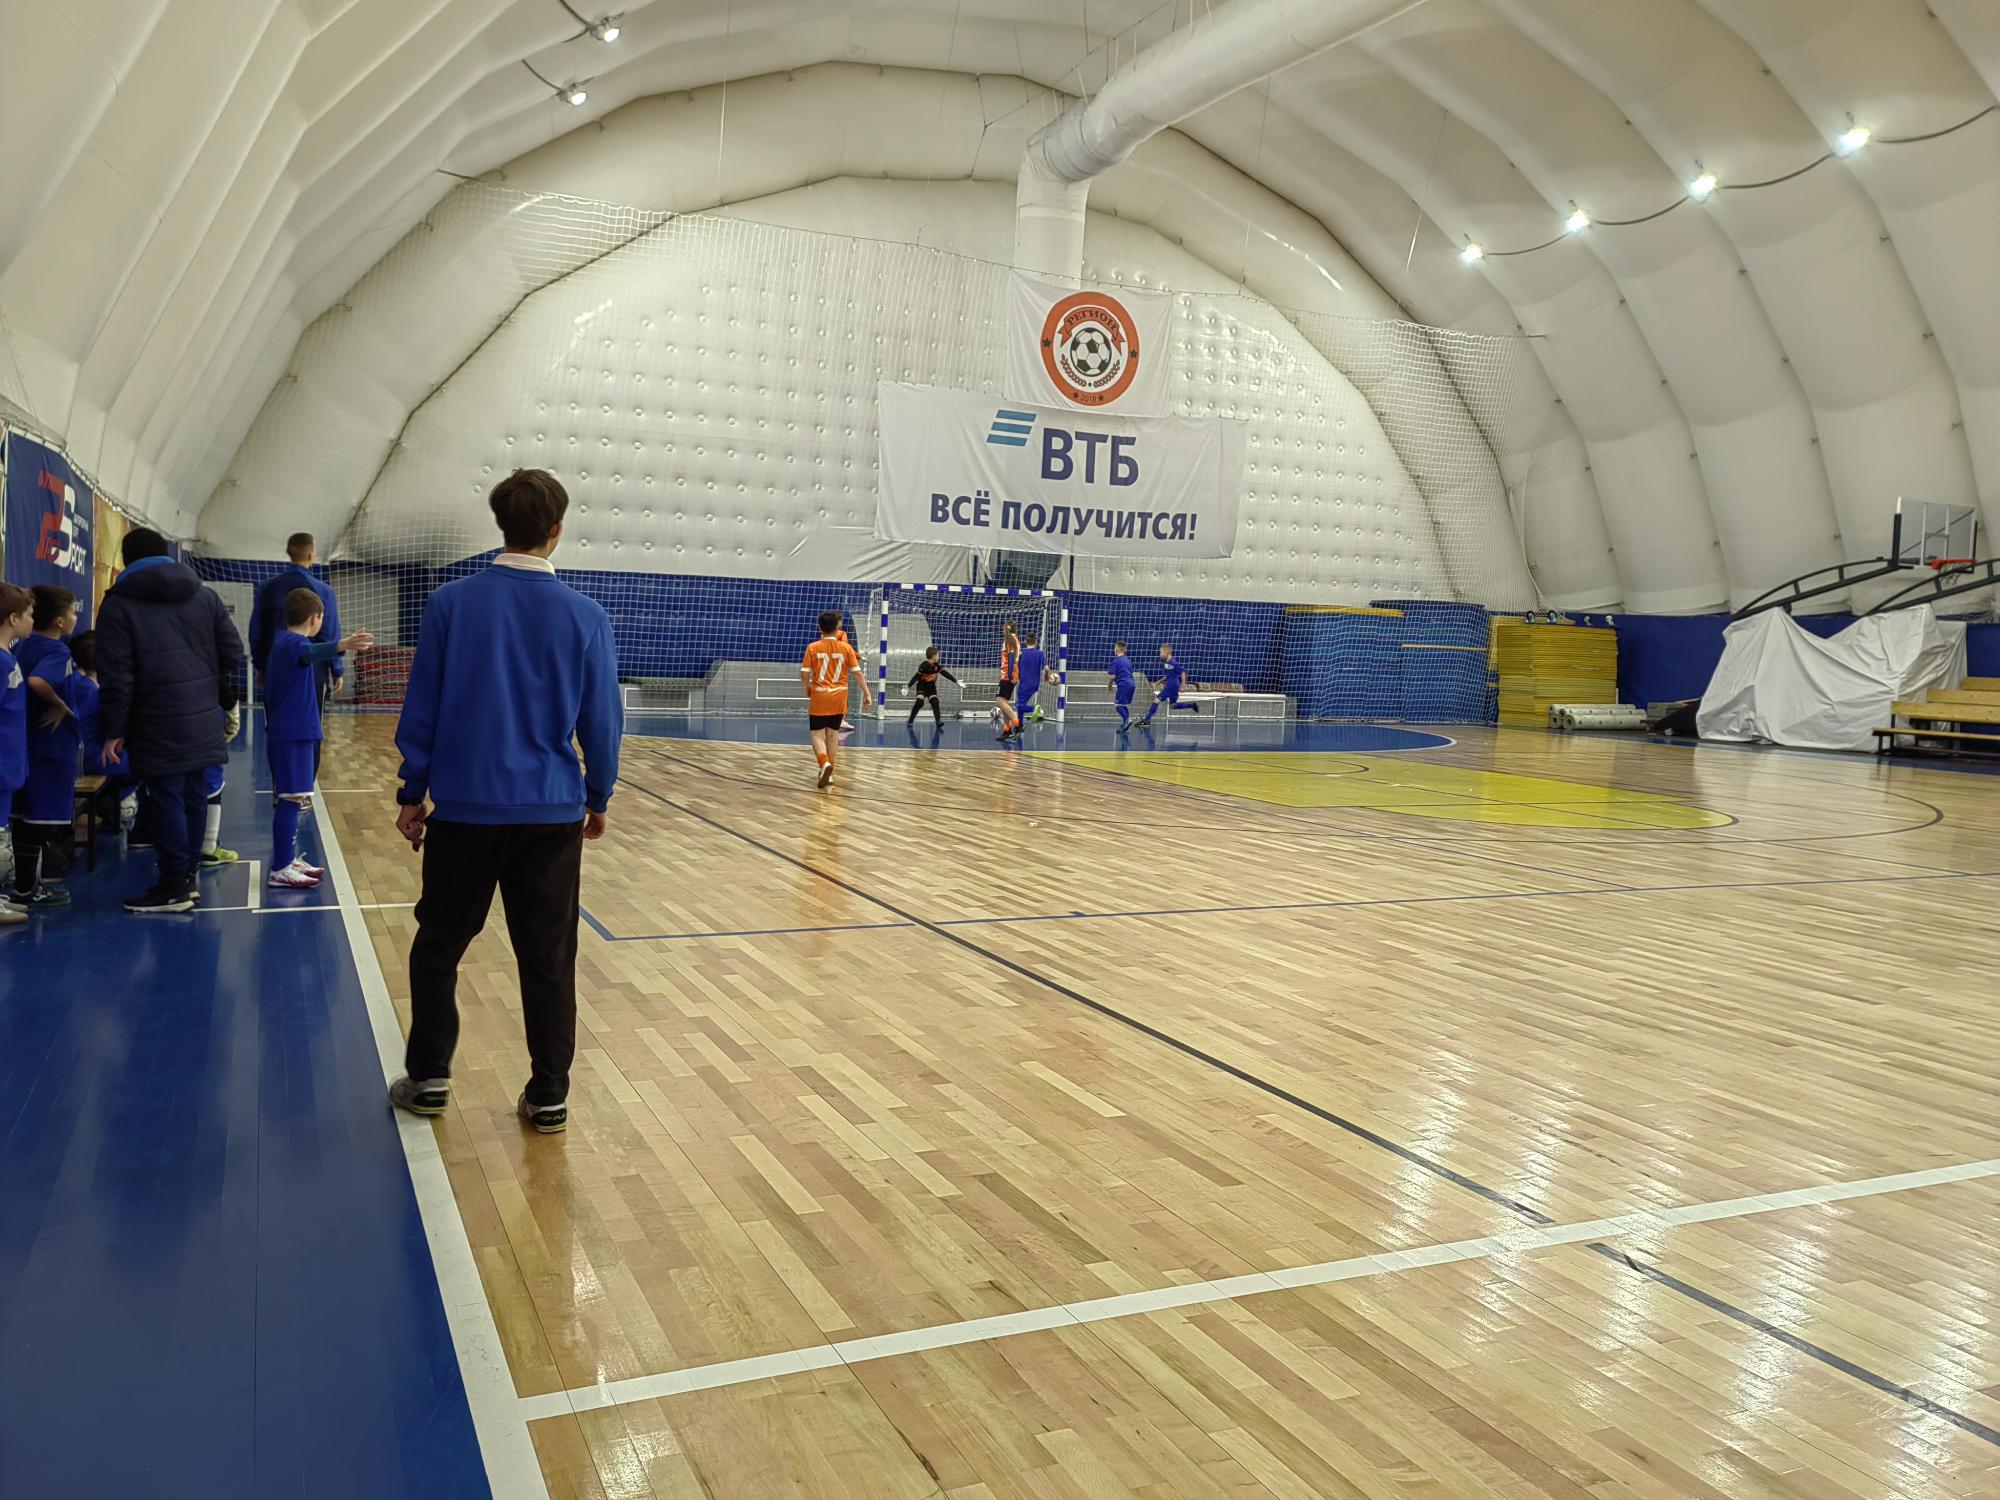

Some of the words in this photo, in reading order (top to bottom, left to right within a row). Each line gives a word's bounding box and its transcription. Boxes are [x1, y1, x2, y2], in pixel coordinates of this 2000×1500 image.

[1066, 309, 1118, 330] РЕГИОН
[1080, 393, 1098, 403] 2018
[1041, 428, 1139, 487] ВТБ
[930, 490, 991, 527] ВСЁ
[1001, 501, 1198, 540] ПОЛУЧИТСЯ!
[816, 652, 845, 682] 77
